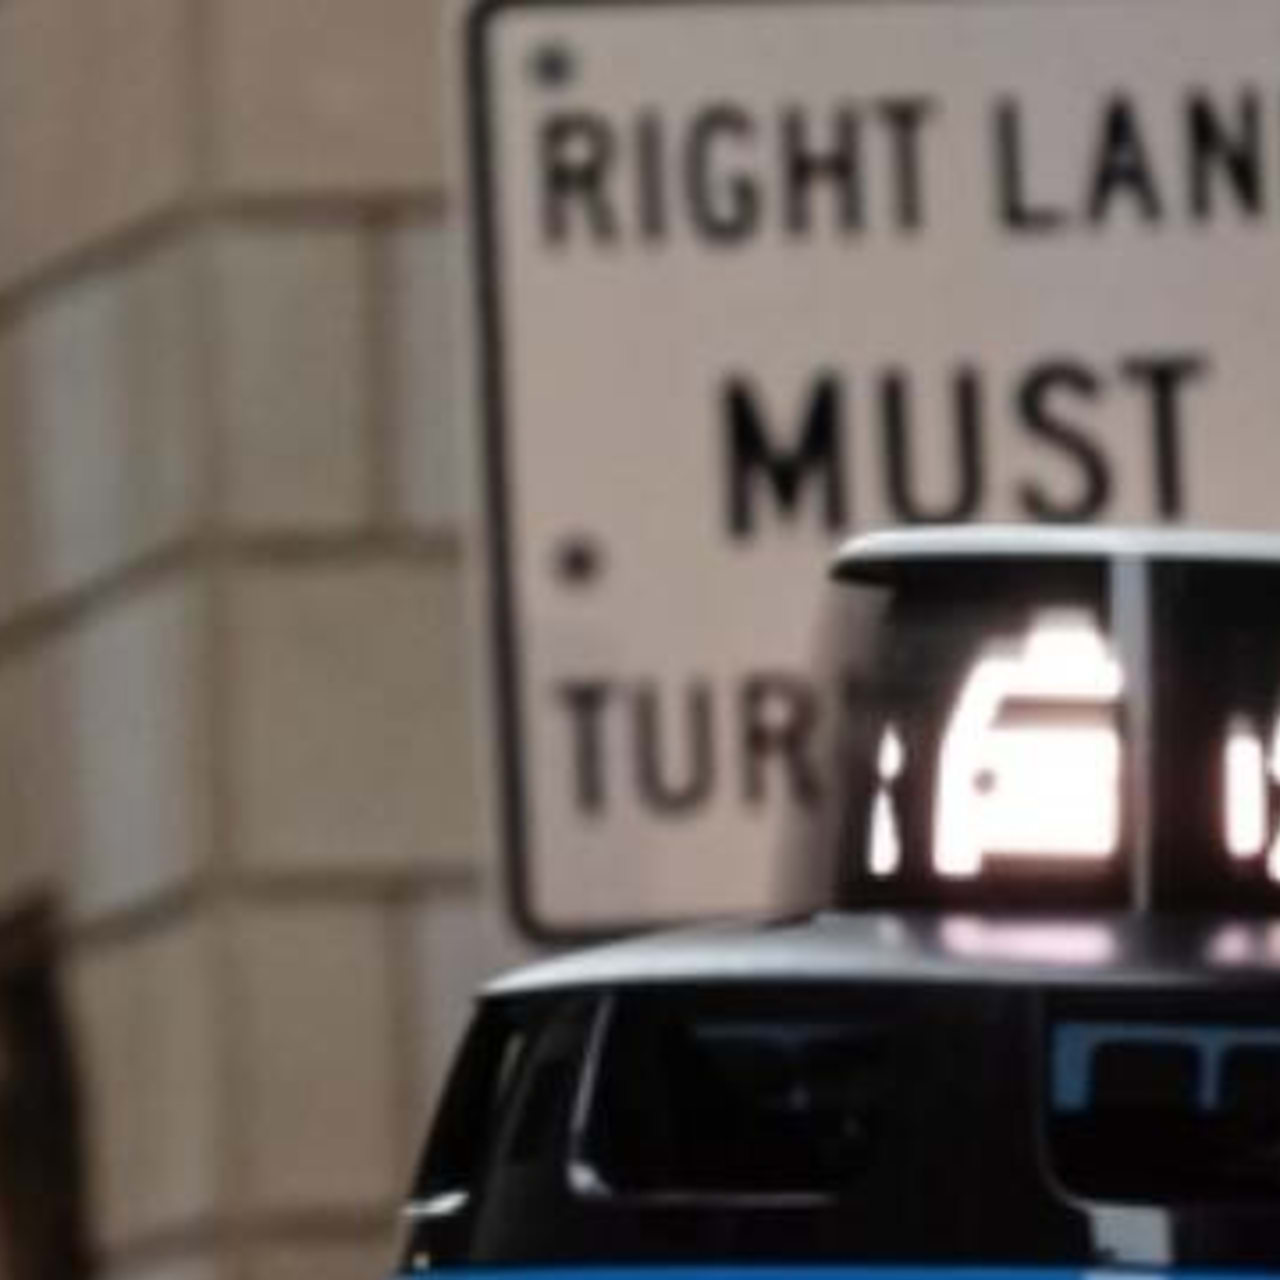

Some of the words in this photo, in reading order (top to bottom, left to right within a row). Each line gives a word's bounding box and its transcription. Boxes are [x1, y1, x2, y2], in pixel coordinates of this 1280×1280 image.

[538, 98, 936, 250] RIGHT
[720, 353, 1208, 540] MUST
[556, 668, 840, 820] TUR
